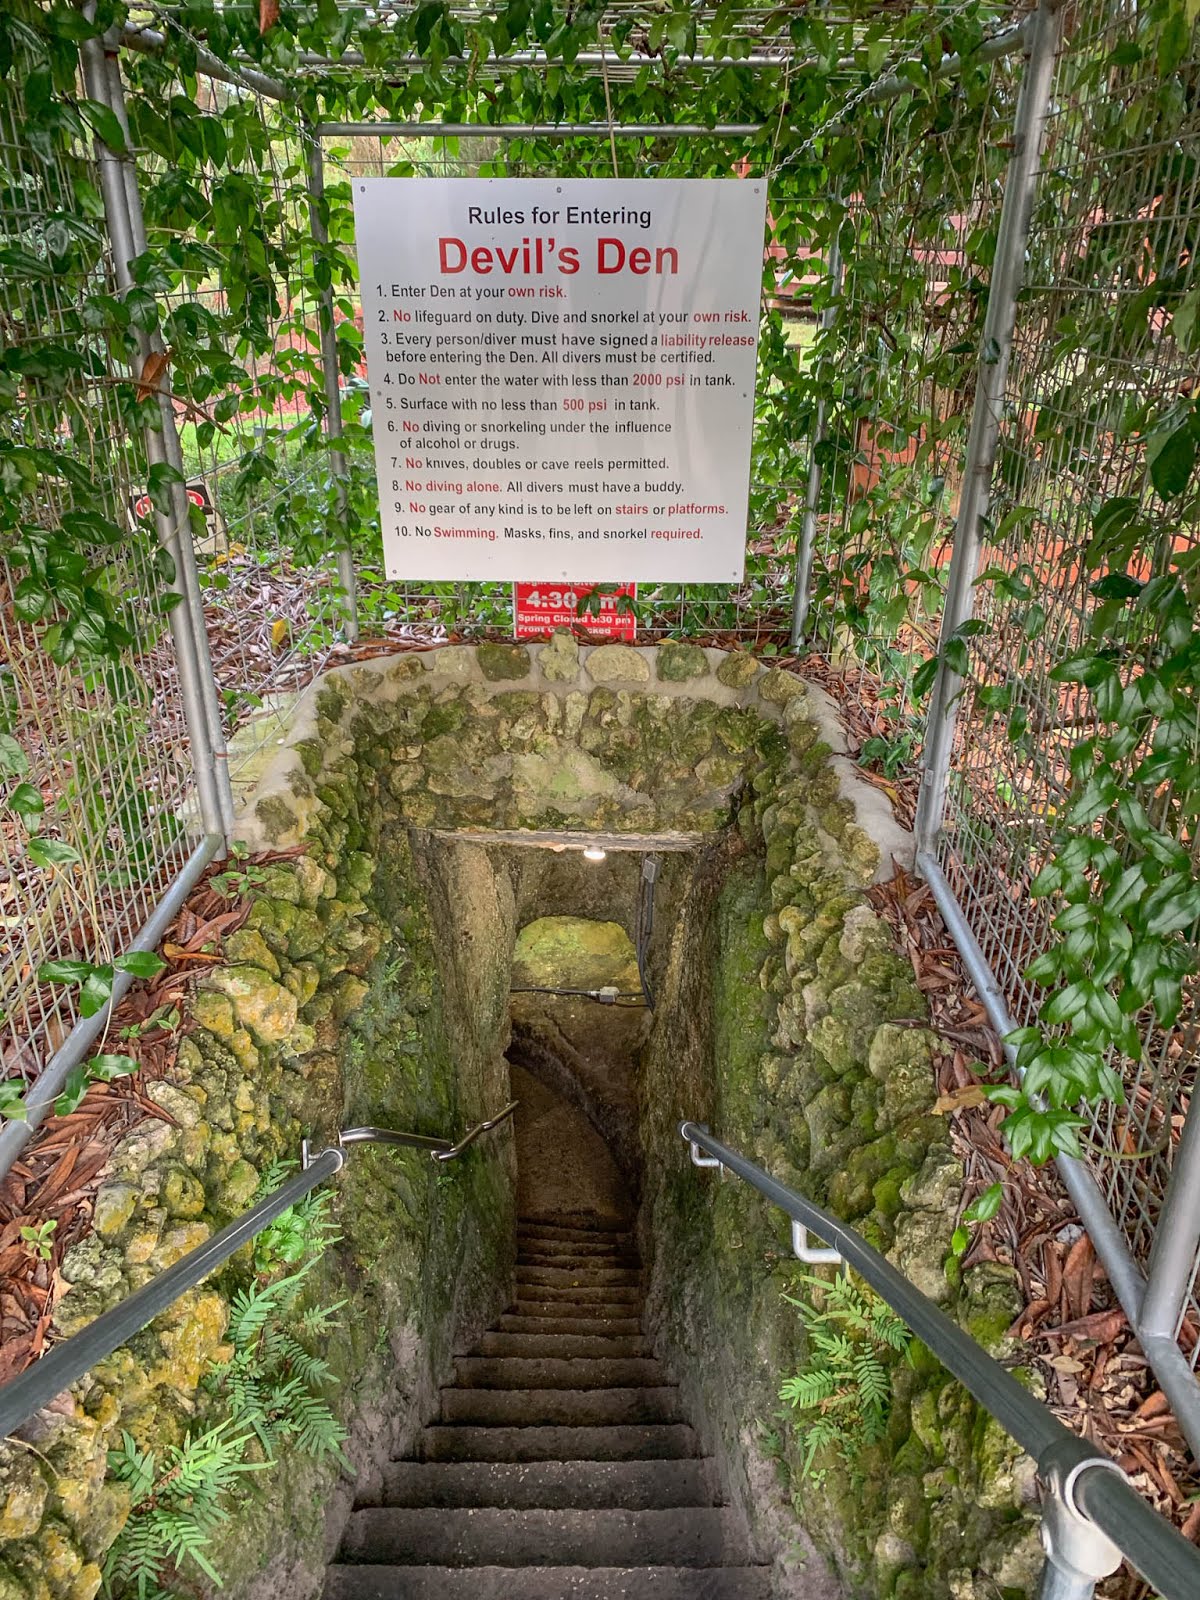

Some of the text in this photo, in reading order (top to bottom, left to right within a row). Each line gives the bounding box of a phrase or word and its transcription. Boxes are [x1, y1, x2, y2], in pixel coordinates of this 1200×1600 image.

[469, 207, 652, 227] Rules for Entering
[439, 238, 678, 274] Devil's Den
[377, 284, 567, 301] 1. Enter Den at your own risk.
[378, 309, 752, 327] 2. No lifeguard on duty. Dive and snorkel at your own risk.
[381, 332, 755, 349] 3. Every person/diver must have signed a liability release
[386, 349, 716, 367] before entering the Den. All divers must be certified.
[384, 372, 735, 389] 4. Do Not enter the water with less than 2000 psi in tank.
[387, 397, 660, 414] 5. Surface with no less than 500 psi in tank.
[388, 419, 672, 436] 6. No diving or snorkeling under the influence
[400, 436, 520, 453] of alcohol or drugs.
[391, 456, 669, 473] 7. No knives, doubles or cave reels permitted.
[393, 479, 684, 495] 8. No diving alone. All divers must have a buddy.
[395, 501, 729, 518] 9. No gear of any kind is to be left on stairs or platforms.
[395, 525, 704, 542] 10. No Swimming. Masks, fins, and snorkel required.
[526, 591, 577, 608] 4:30
[518, 613, 550, 623] Spring
[615, 617, 631, 626] pm
